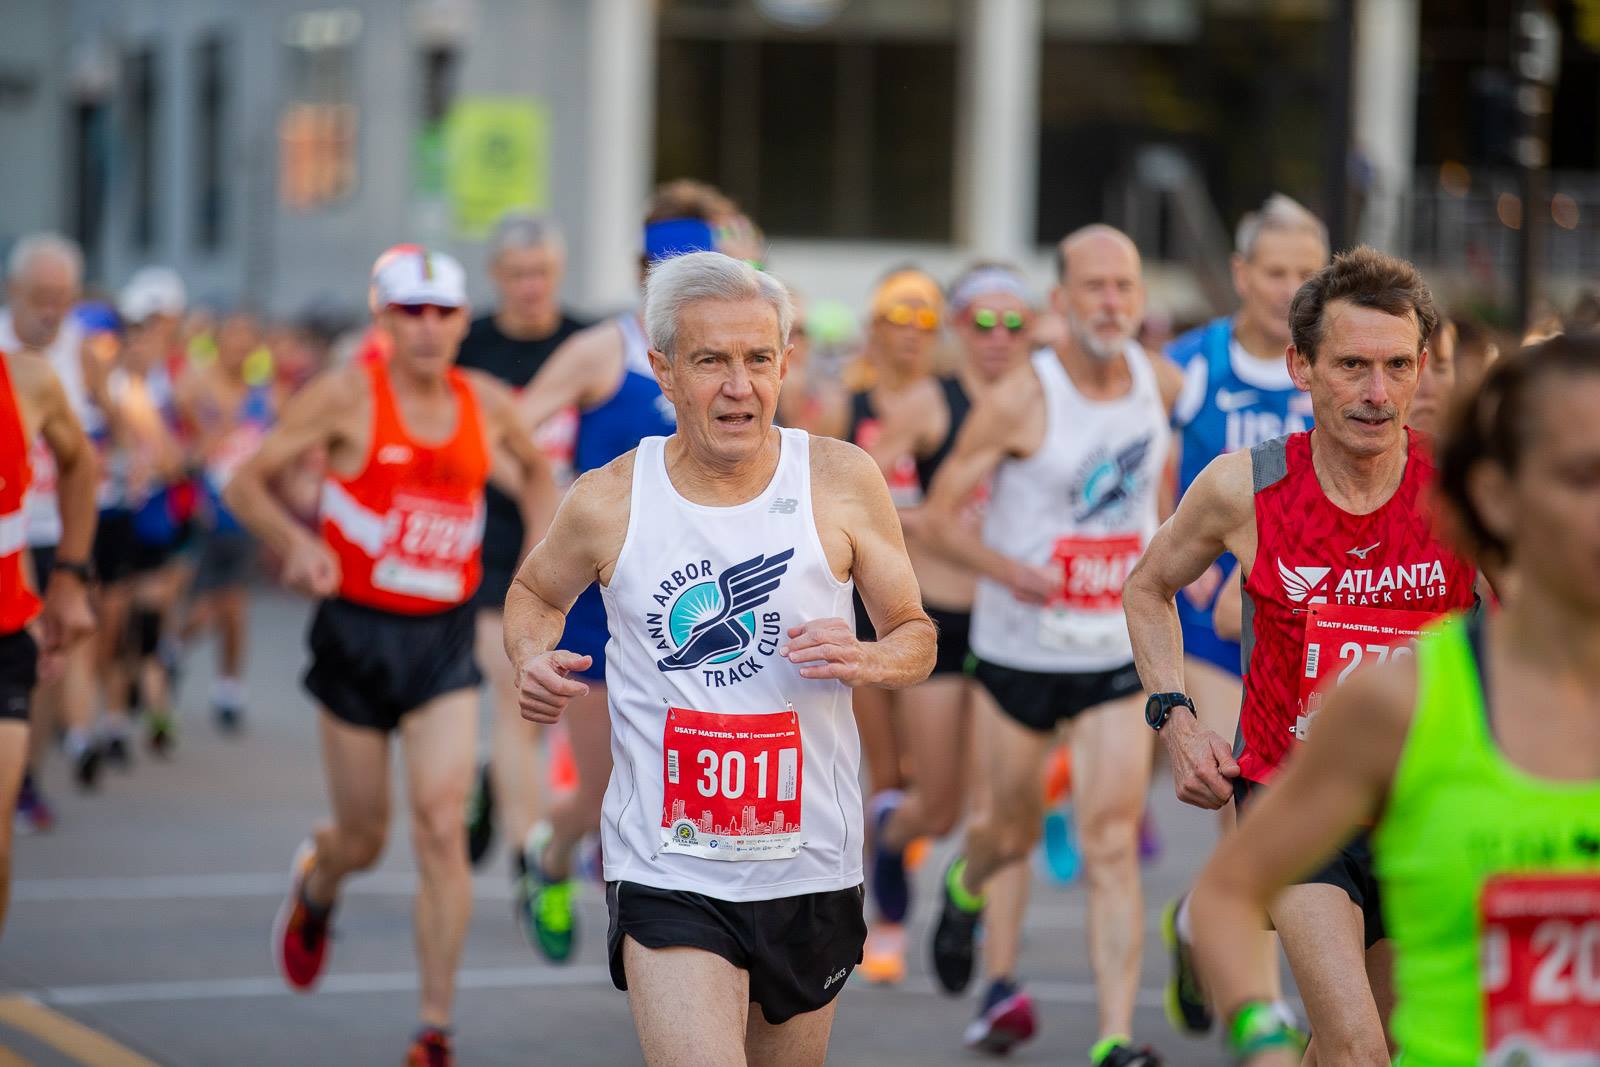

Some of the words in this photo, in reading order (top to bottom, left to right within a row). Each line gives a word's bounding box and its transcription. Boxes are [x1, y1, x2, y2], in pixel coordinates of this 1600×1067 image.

[653, 559, 713, 607] ARBOR
[1335, 560, 1446, 593] ATLANTA
[1336, 593, 1392, 605] TRACK
[1404, 585, 1447, 601] CLUB
[647, 613, 670, 650] ANN
[1317, 620, 1341, 629] USATF
[1342, 624, 1380, 634] MASTERS,
[703, 656, 764, 687] TRACK
[759, 611, 780, 656] CLUB
[674, 726, 697, 736] USATF
[697, 730, 735, 739] MASTERS,
[697, 749, 769, 799] 301
